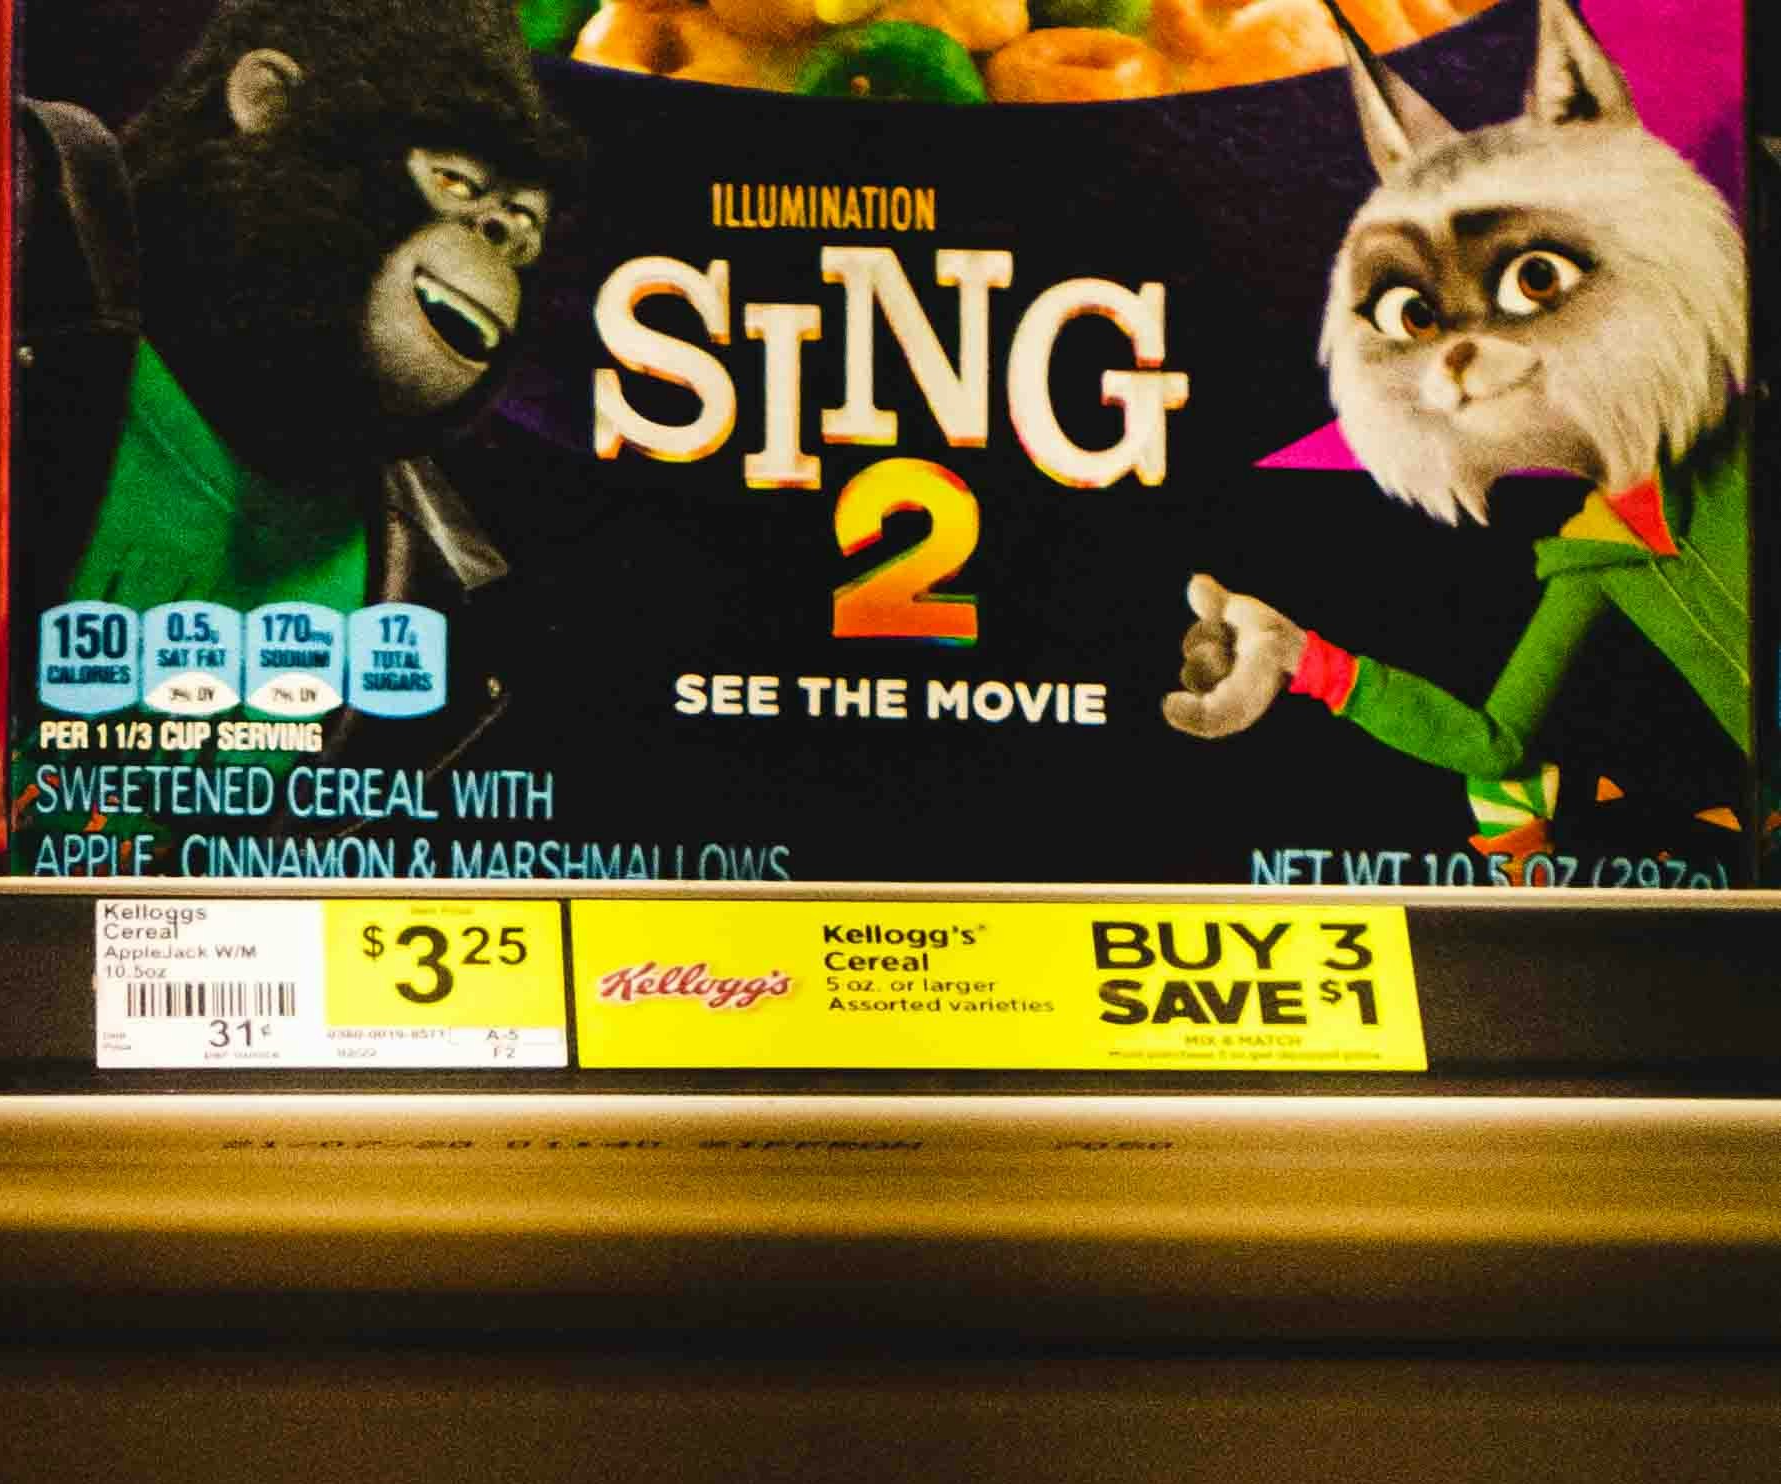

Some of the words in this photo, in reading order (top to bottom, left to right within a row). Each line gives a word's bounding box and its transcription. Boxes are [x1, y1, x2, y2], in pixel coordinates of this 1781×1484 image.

[712, 183, 937, 231] ILLUMINATION
[592, 244, 1189, 490] SING
[832, 456, 980, 648] 2
[53, 613, 126, 659] 150
[47, 665, 131, 685] CALORIES
[157, 649, 189, 668] SAT
[196, 649, 225, 668] FAT
[260, 649, 331, 669] SODIUM
[371, 650, 422, 671] TOTAL
[362, 671, 433, 693] SUGARS
[673, 673, 779, 717] SEE
[798, 675, 908, 719] THE
[926, 681, 1107, 725] MOVIE
[39, 720, 92, 751] PER
[114, 721, 152, 751] 1/3
[160, 721, 212, 751] CUP
[218, 721, 323, 752] SERVING
[34, 763, 275, 818] SWEETENED
[287, 766, 439, 820] CEREAL
[452, 769, 554, 821] WITH
[33, 833, 163, 878] APPLE
[181, 834, 395, 878] CINNAMON
[408, 837, 436, 879] &
[450, 839, 792, 881] MARSHMALLOWS
[1250, 847, 1333, 886] NET
[1342, 850, 1414, 886] WT
[1424, 851, 1513, 887] 105
[103, 921, 179, 940] Cereal
[104, 903, 207, 925] Kelloggs
[824, 951, 929, 972] Cereal
[1092, 920, 1292, 971] BUY
[1319, 923, 1373, 971] 3
[599, 960, 792, 1010] Kellogg's
[827, 977, 840, 993] 5
[891, 979, 914, 993] or
[923, 977, 995, 997] larger
[1098, 979, 1308, 1025] SAVE
[1319, 979, 1379, 1025] $1
[828, 997, 941, 1013] Assorted
[948, 997, 1055, 1014] varieties
